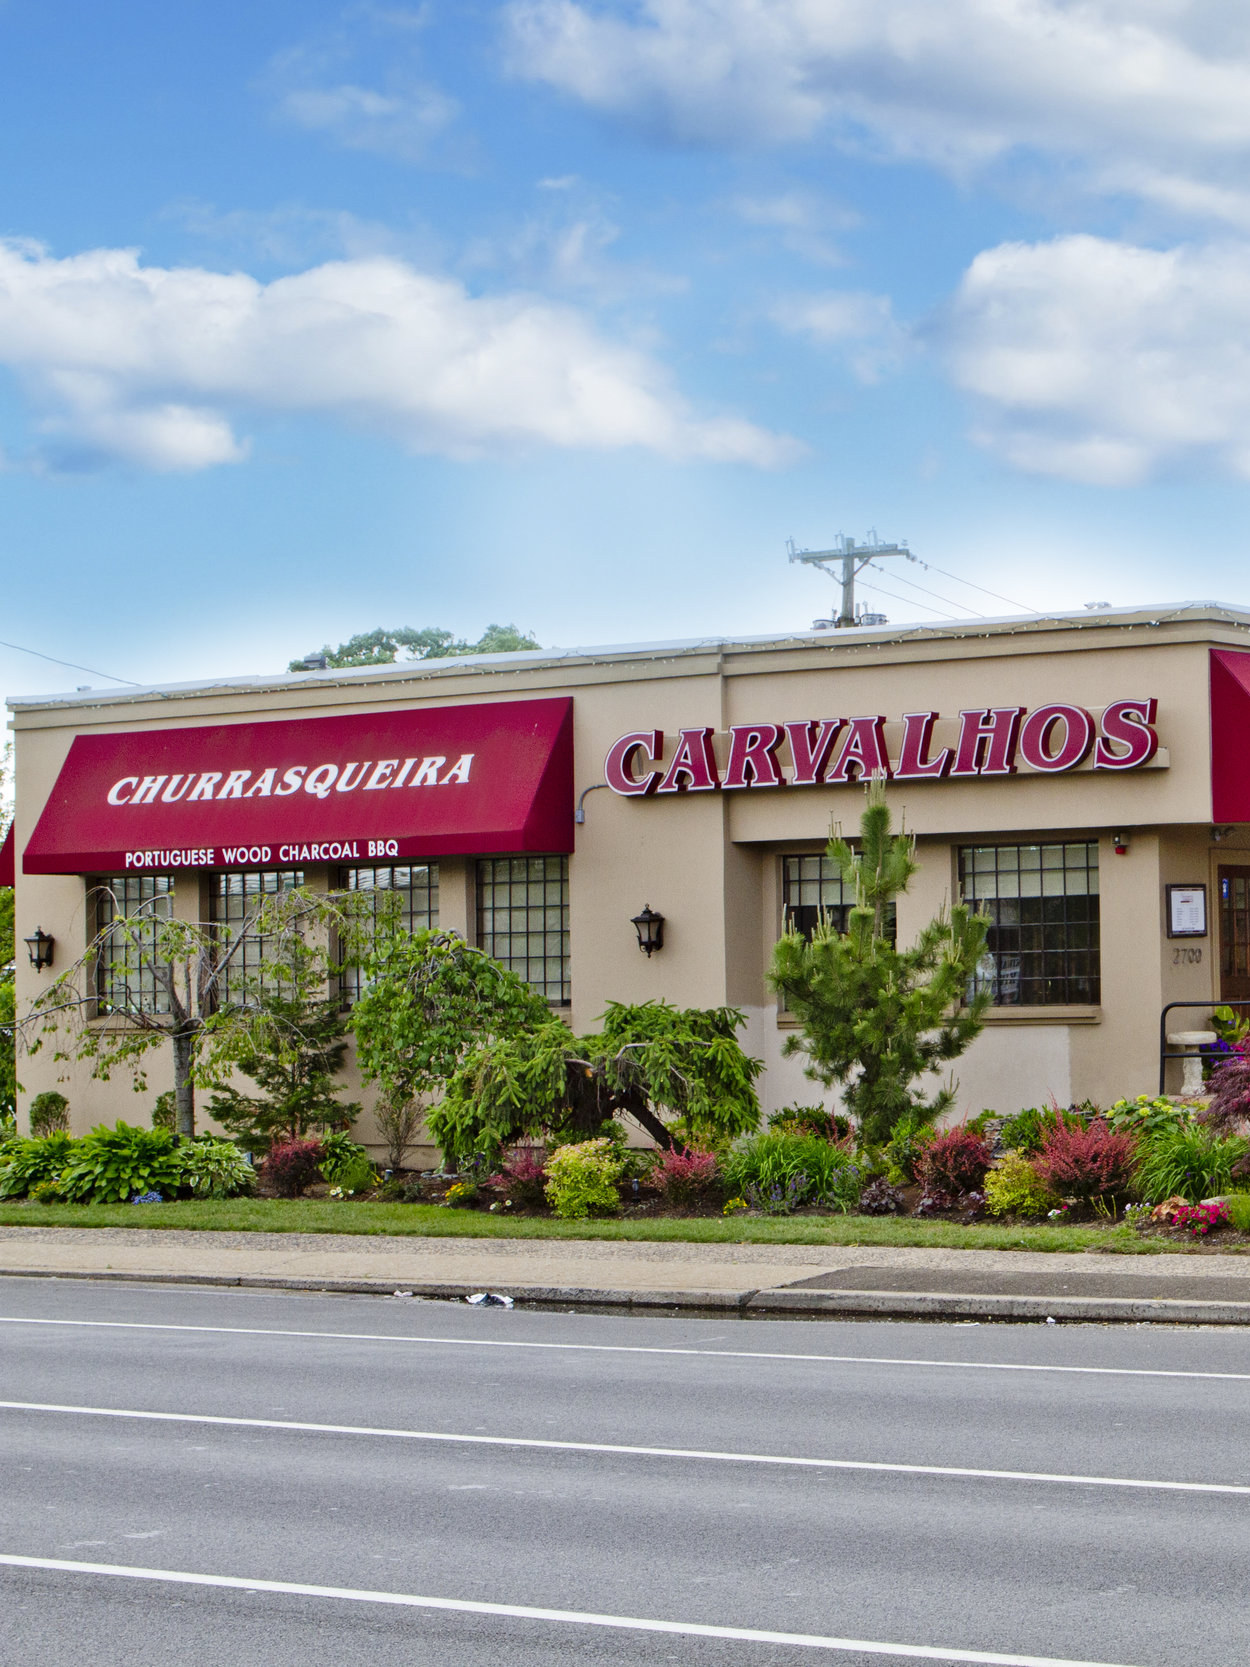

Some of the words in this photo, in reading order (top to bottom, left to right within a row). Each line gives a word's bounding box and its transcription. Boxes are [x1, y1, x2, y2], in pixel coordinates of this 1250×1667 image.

[604, 697, 1158, 796] CARVALHOS
[106, 753, 475, 806] CHURRASQUEIRA
[125, 848, 215, 868] PORTUGUESE
[222, 846, 272, 864] WOOD
[279, 841, 360, 862] CHARCOAL
[368, 839, 399, 858] BBQ
